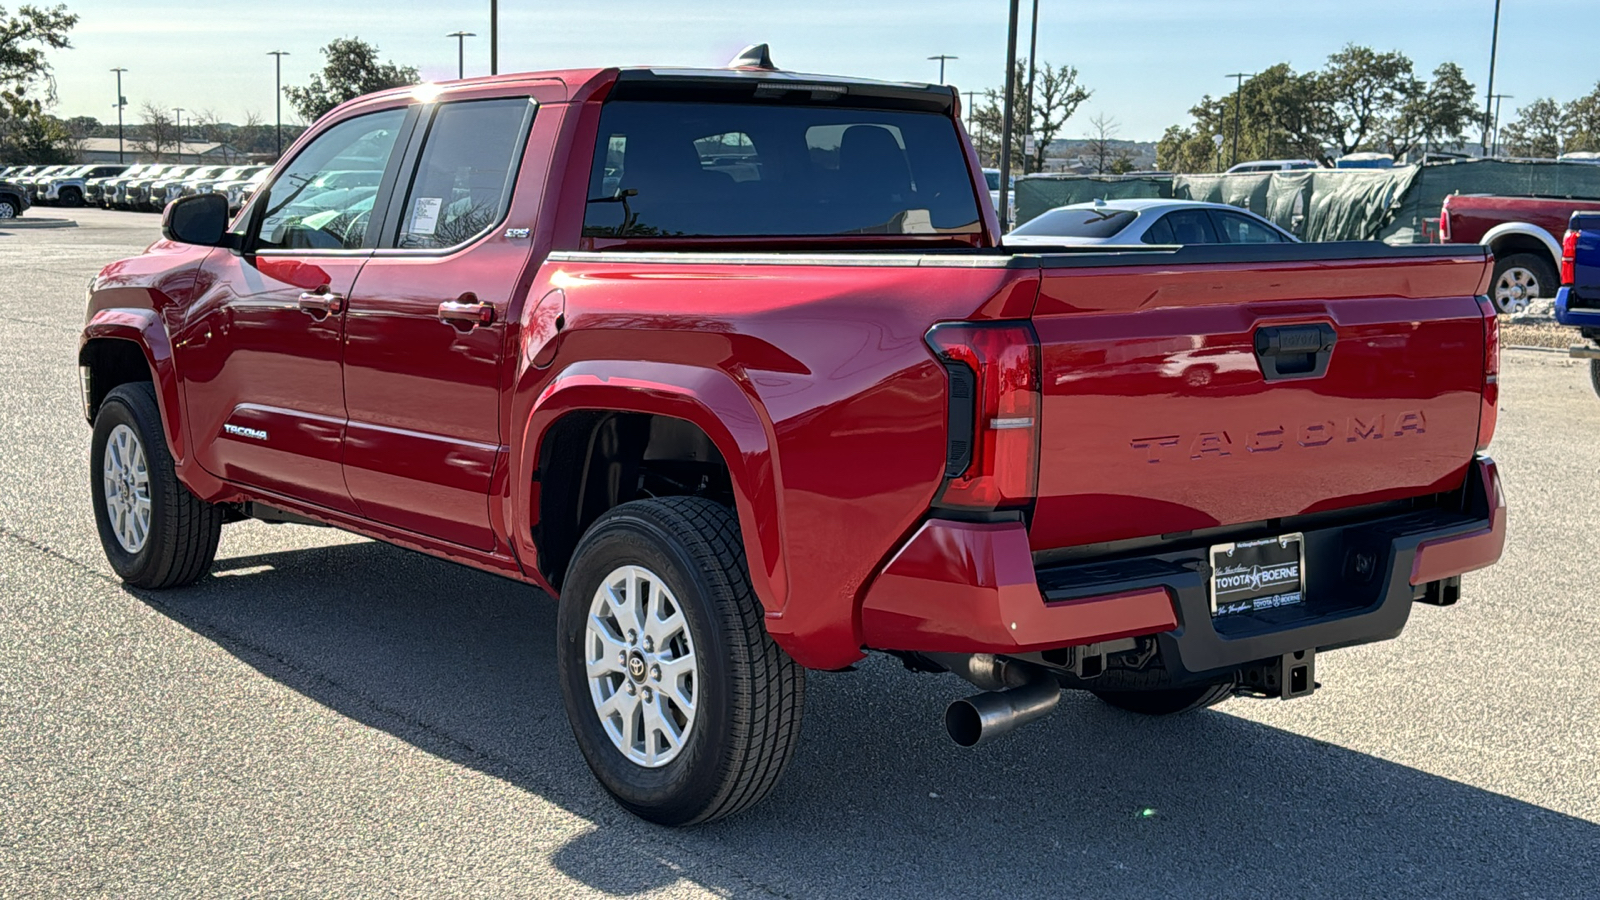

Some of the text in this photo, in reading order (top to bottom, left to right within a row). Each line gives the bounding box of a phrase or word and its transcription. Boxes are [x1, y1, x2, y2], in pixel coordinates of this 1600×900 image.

[223, 423, 268, 441] TACOMA
[1130, 410, 1427, 463] TACOMA
[1216, 574, 1251, 589] TOYOTA
[1262, 566, 1299, 581] BOERNE
[1253, 600, 1272, 608] TOYOTA
